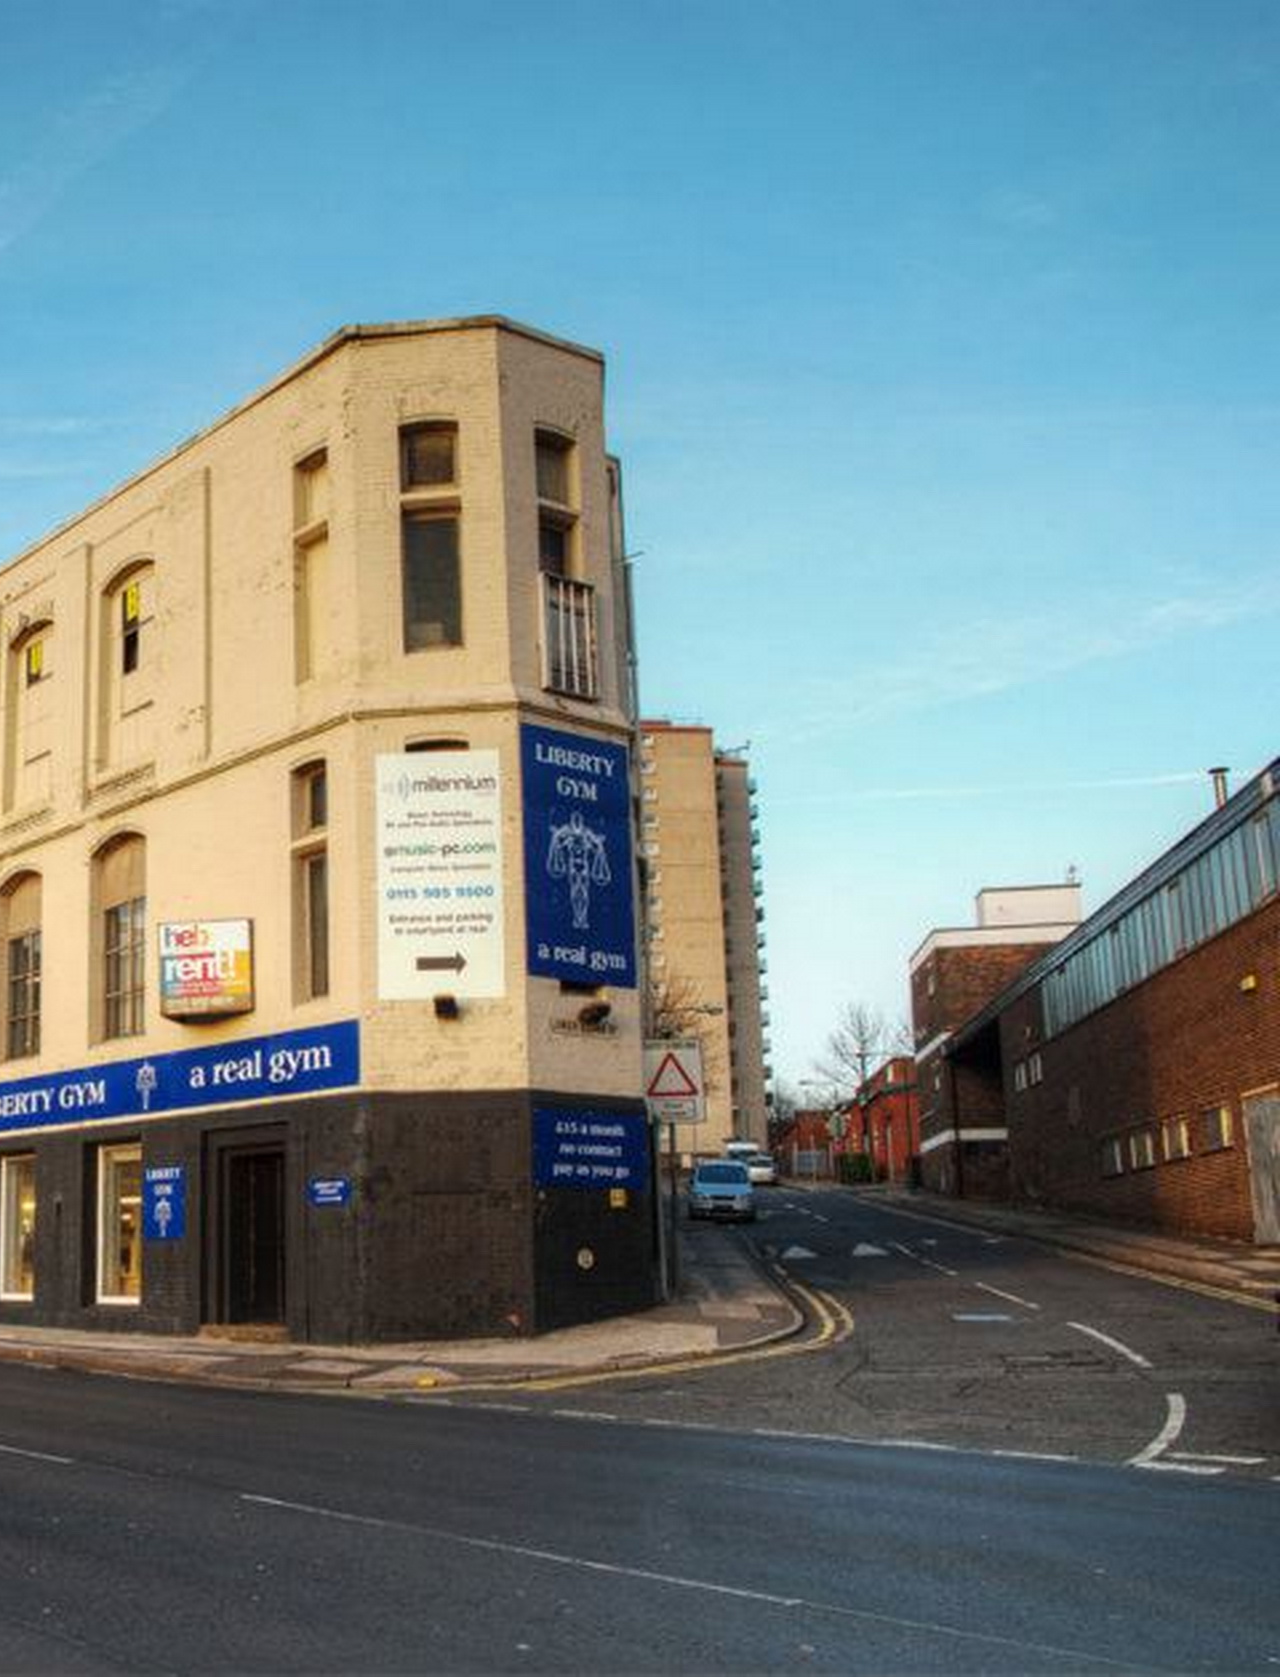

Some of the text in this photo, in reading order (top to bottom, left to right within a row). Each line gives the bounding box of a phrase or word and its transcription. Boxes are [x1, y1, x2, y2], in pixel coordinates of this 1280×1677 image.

[535, 744, 614, 777] LIBERTY
[556, 776, 598, 801] GYM
[538, 943, 627, 972] a real gym
[58, 1080, 106, 1111] GYM
[189, 1065, 206, 1089] a
[213, 1050, 262, 1086] real
[267, 1044, 332, 1082] gym
